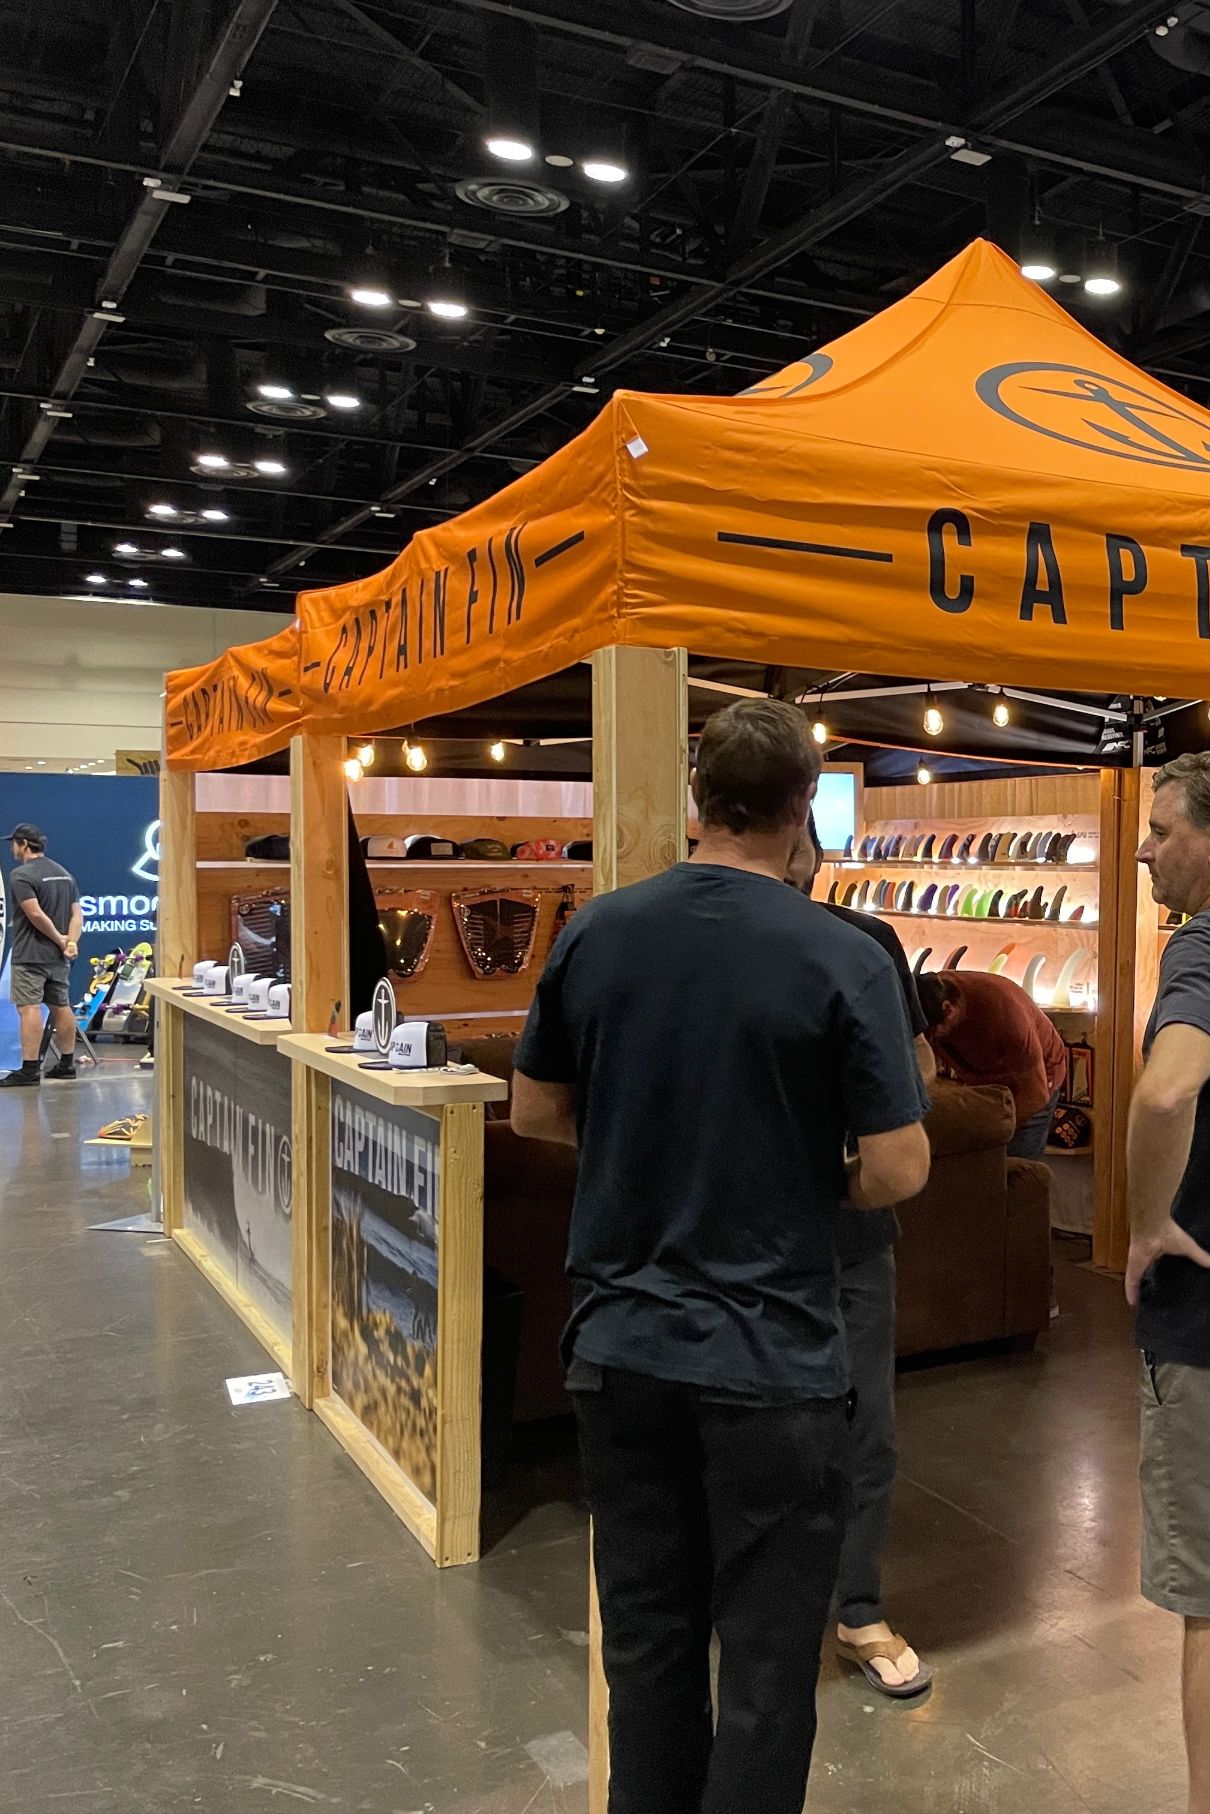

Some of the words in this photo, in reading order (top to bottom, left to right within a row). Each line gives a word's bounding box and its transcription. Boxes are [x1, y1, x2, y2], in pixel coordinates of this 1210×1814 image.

[323, 566, 449, 695] CAPTAIN
[465, 521, 528, 645] FIN
[182, 675, 244, 742] CAPTAIN
[81, 919, 137, 933] MAKING
[191, 1075, 244, 1160] CAPTAIN
[248, 1112, 275, 1196] FIN
[334, 1094, 407, 1197] CAPTAIN
